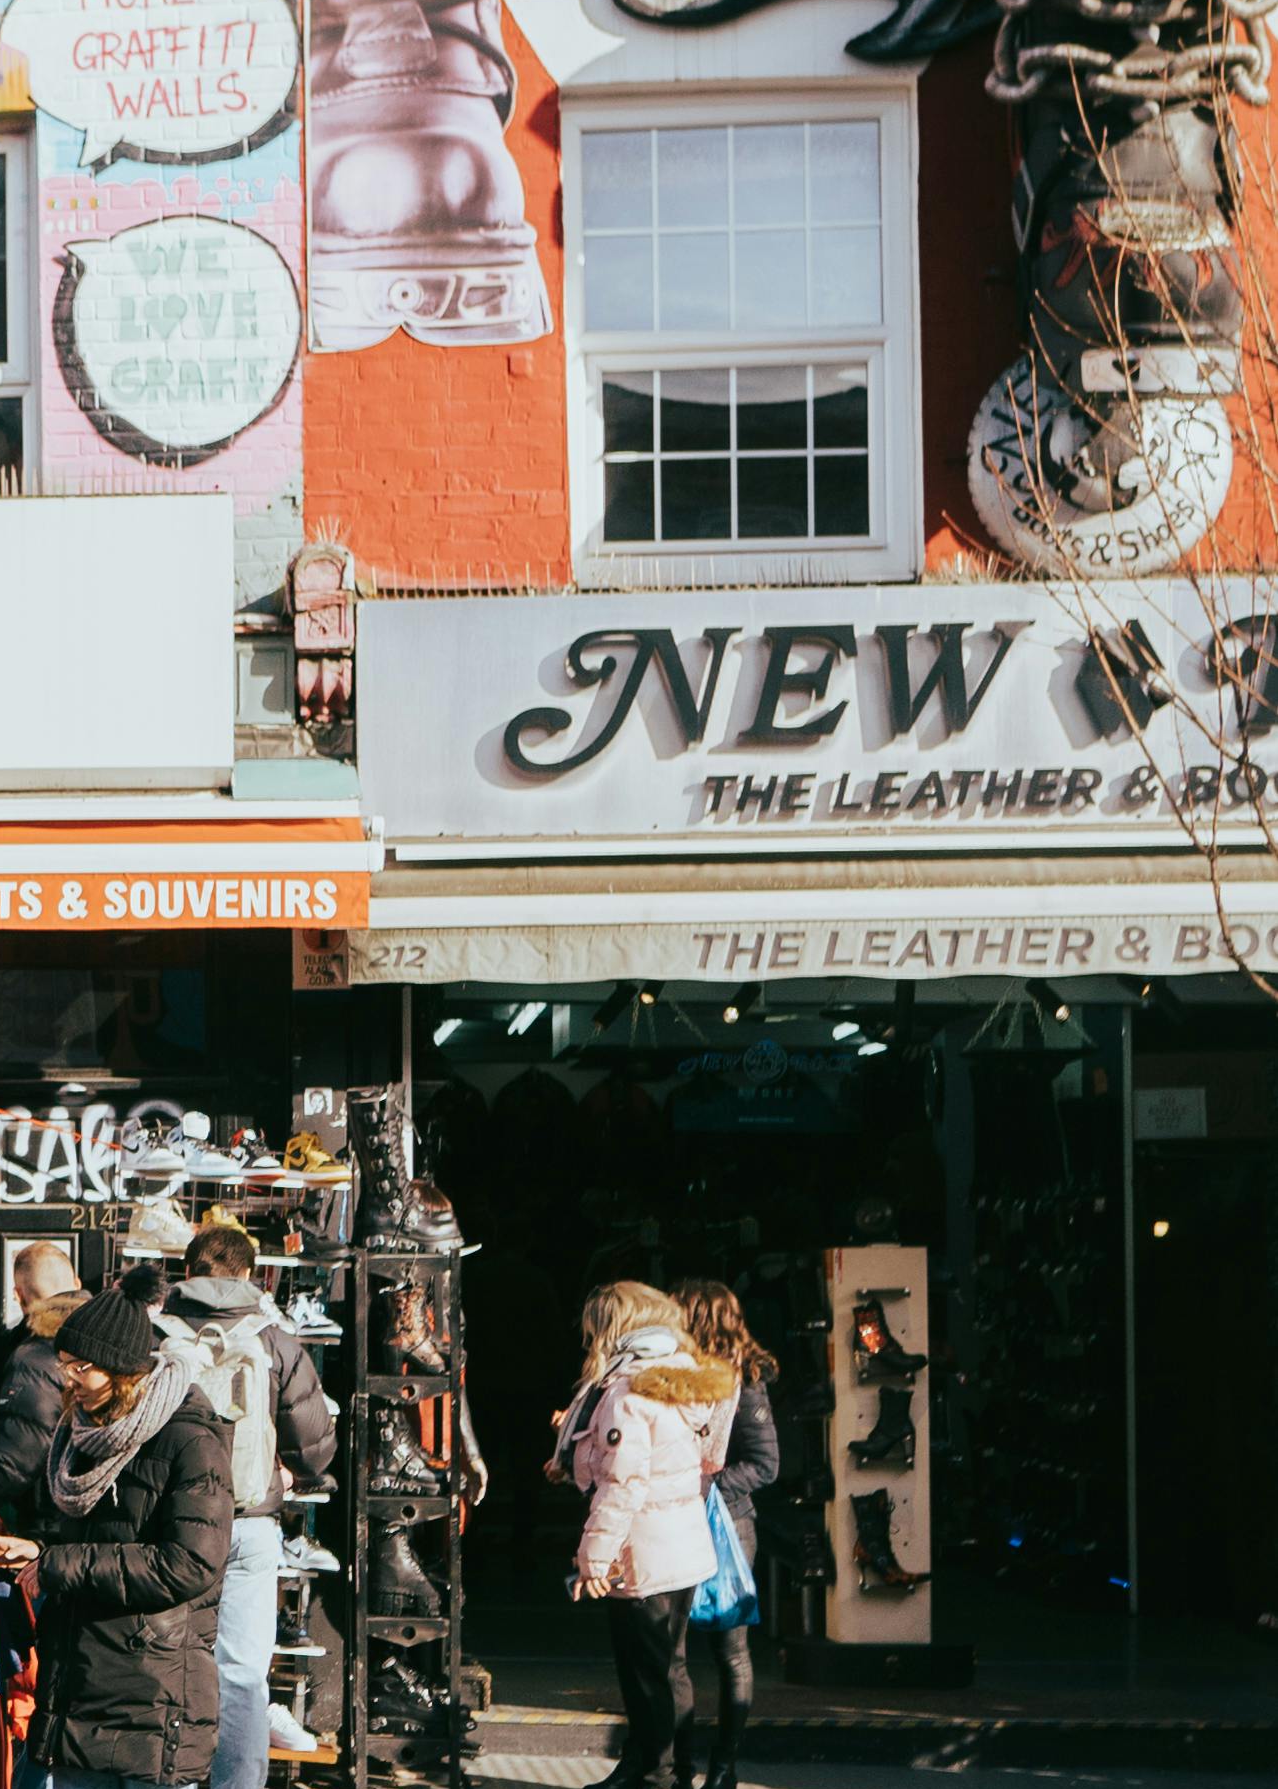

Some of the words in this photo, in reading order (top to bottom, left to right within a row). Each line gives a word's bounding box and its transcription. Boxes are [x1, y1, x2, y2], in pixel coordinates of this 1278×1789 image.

[72, 21, 259, 72] GRAFFITI
[106, 72, 260, 119] WALLS.
[126, 236, 229, 279] WE
[1088, 534, 1113, 566] &
[503, 619, 1036, 777] NEW
[703, 773, 811, 814] THE
[827, 766, 1103, 812] LEATHER
[1122, 765, 1160, 807] &
[1181, 765, 1278, 807] BO
[58, 881, 88, 920] &
[103, 879, 339, 921] SOUVENIRS
[368, 945, 428, 969] 212
[693, 931, 801, 970] THE
[824, 927, 1095, 969] LEATHER
[1115, 924, 1152, 964] &
[1173, 924, 1278, 964] BO
[70, 1206, 117, 1231] 214
